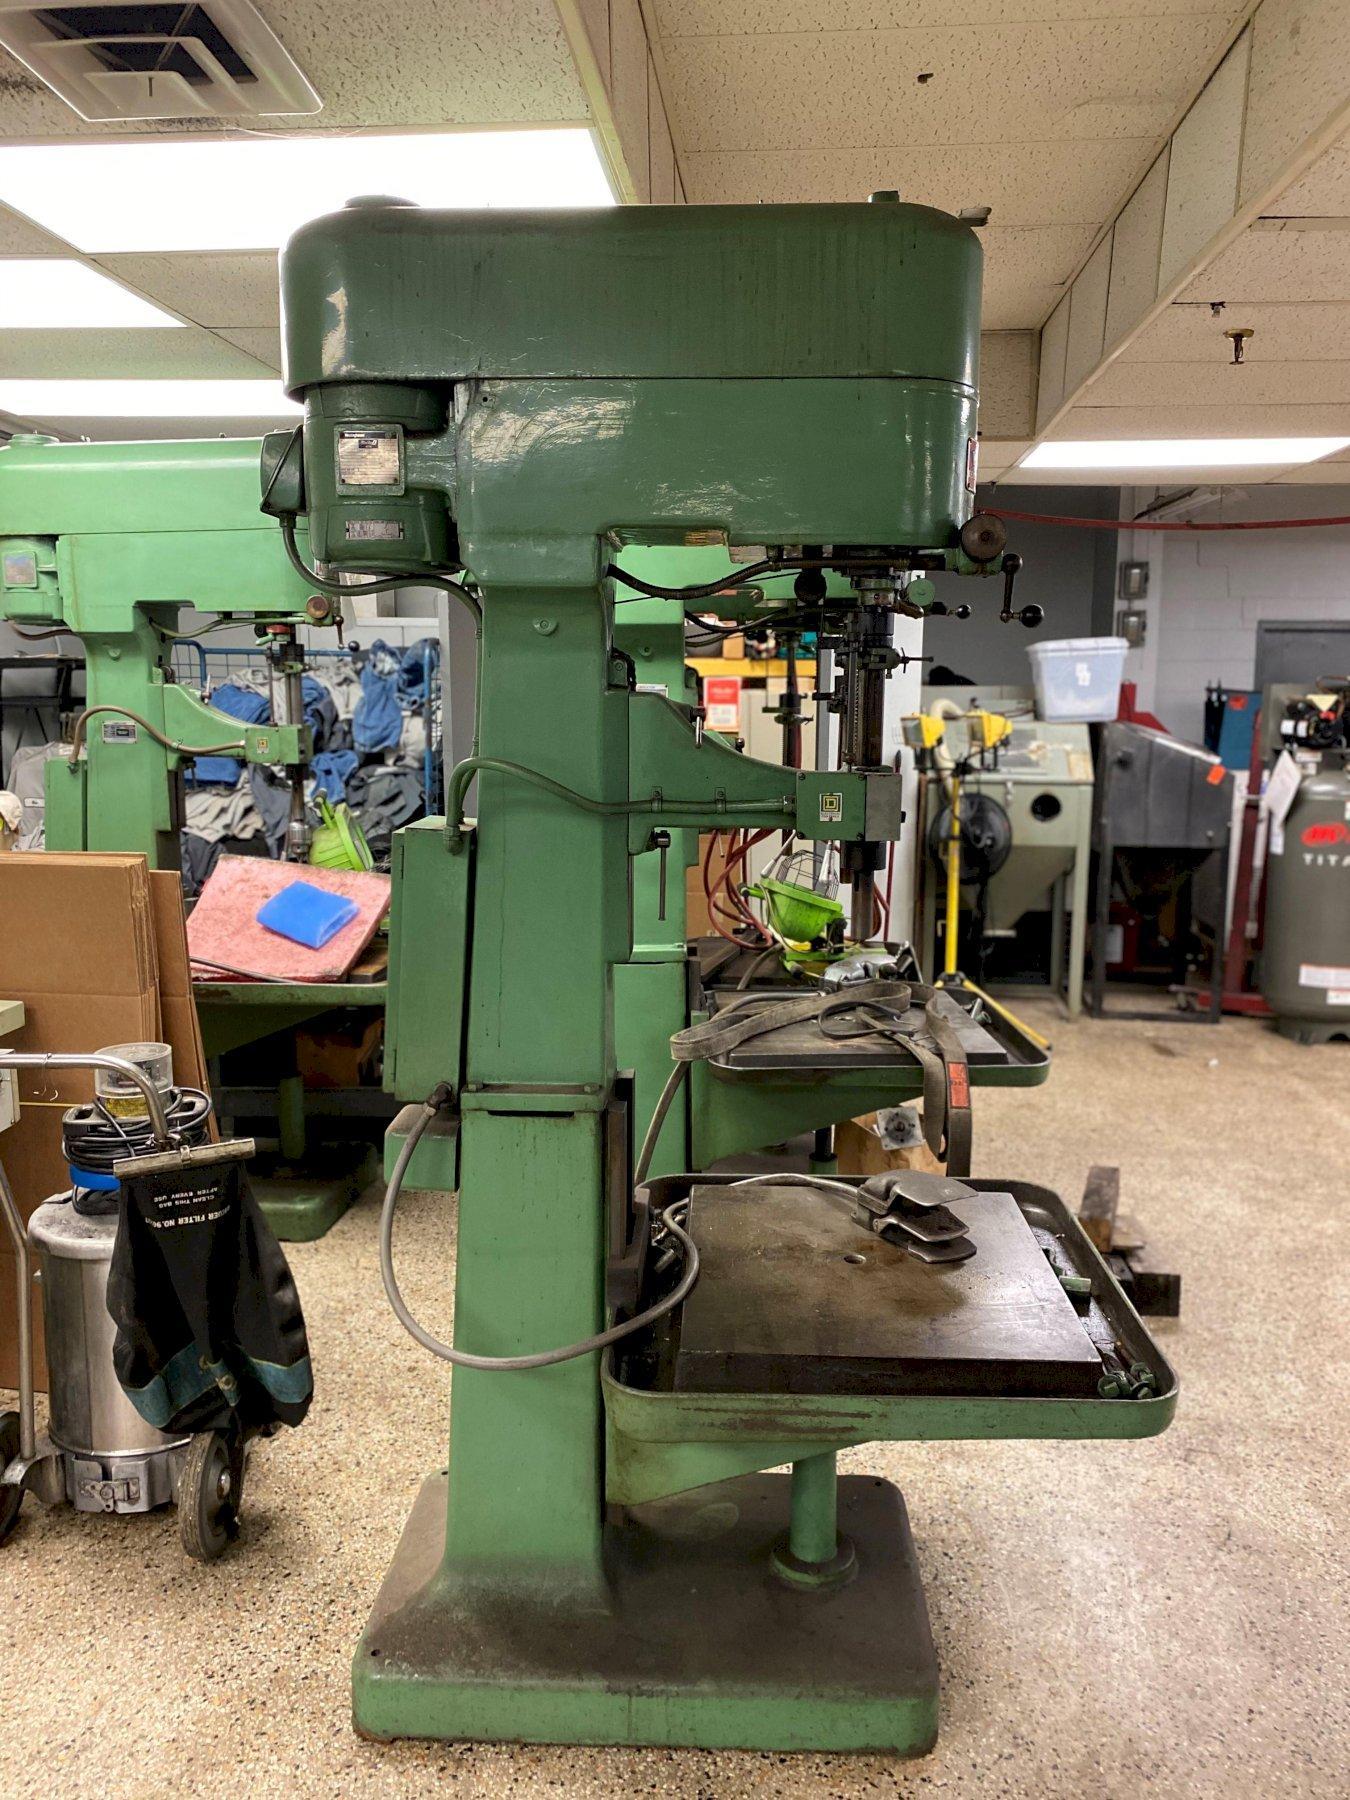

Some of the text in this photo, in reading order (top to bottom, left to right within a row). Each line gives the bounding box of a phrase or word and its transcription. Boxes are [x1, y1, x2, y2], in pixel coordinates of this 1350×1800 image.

[197, 1187, 218, 1195] AFTER
[193, 1195, 214, 1203] CLEAN
[178, 1214, 205, 1225] FILTER
